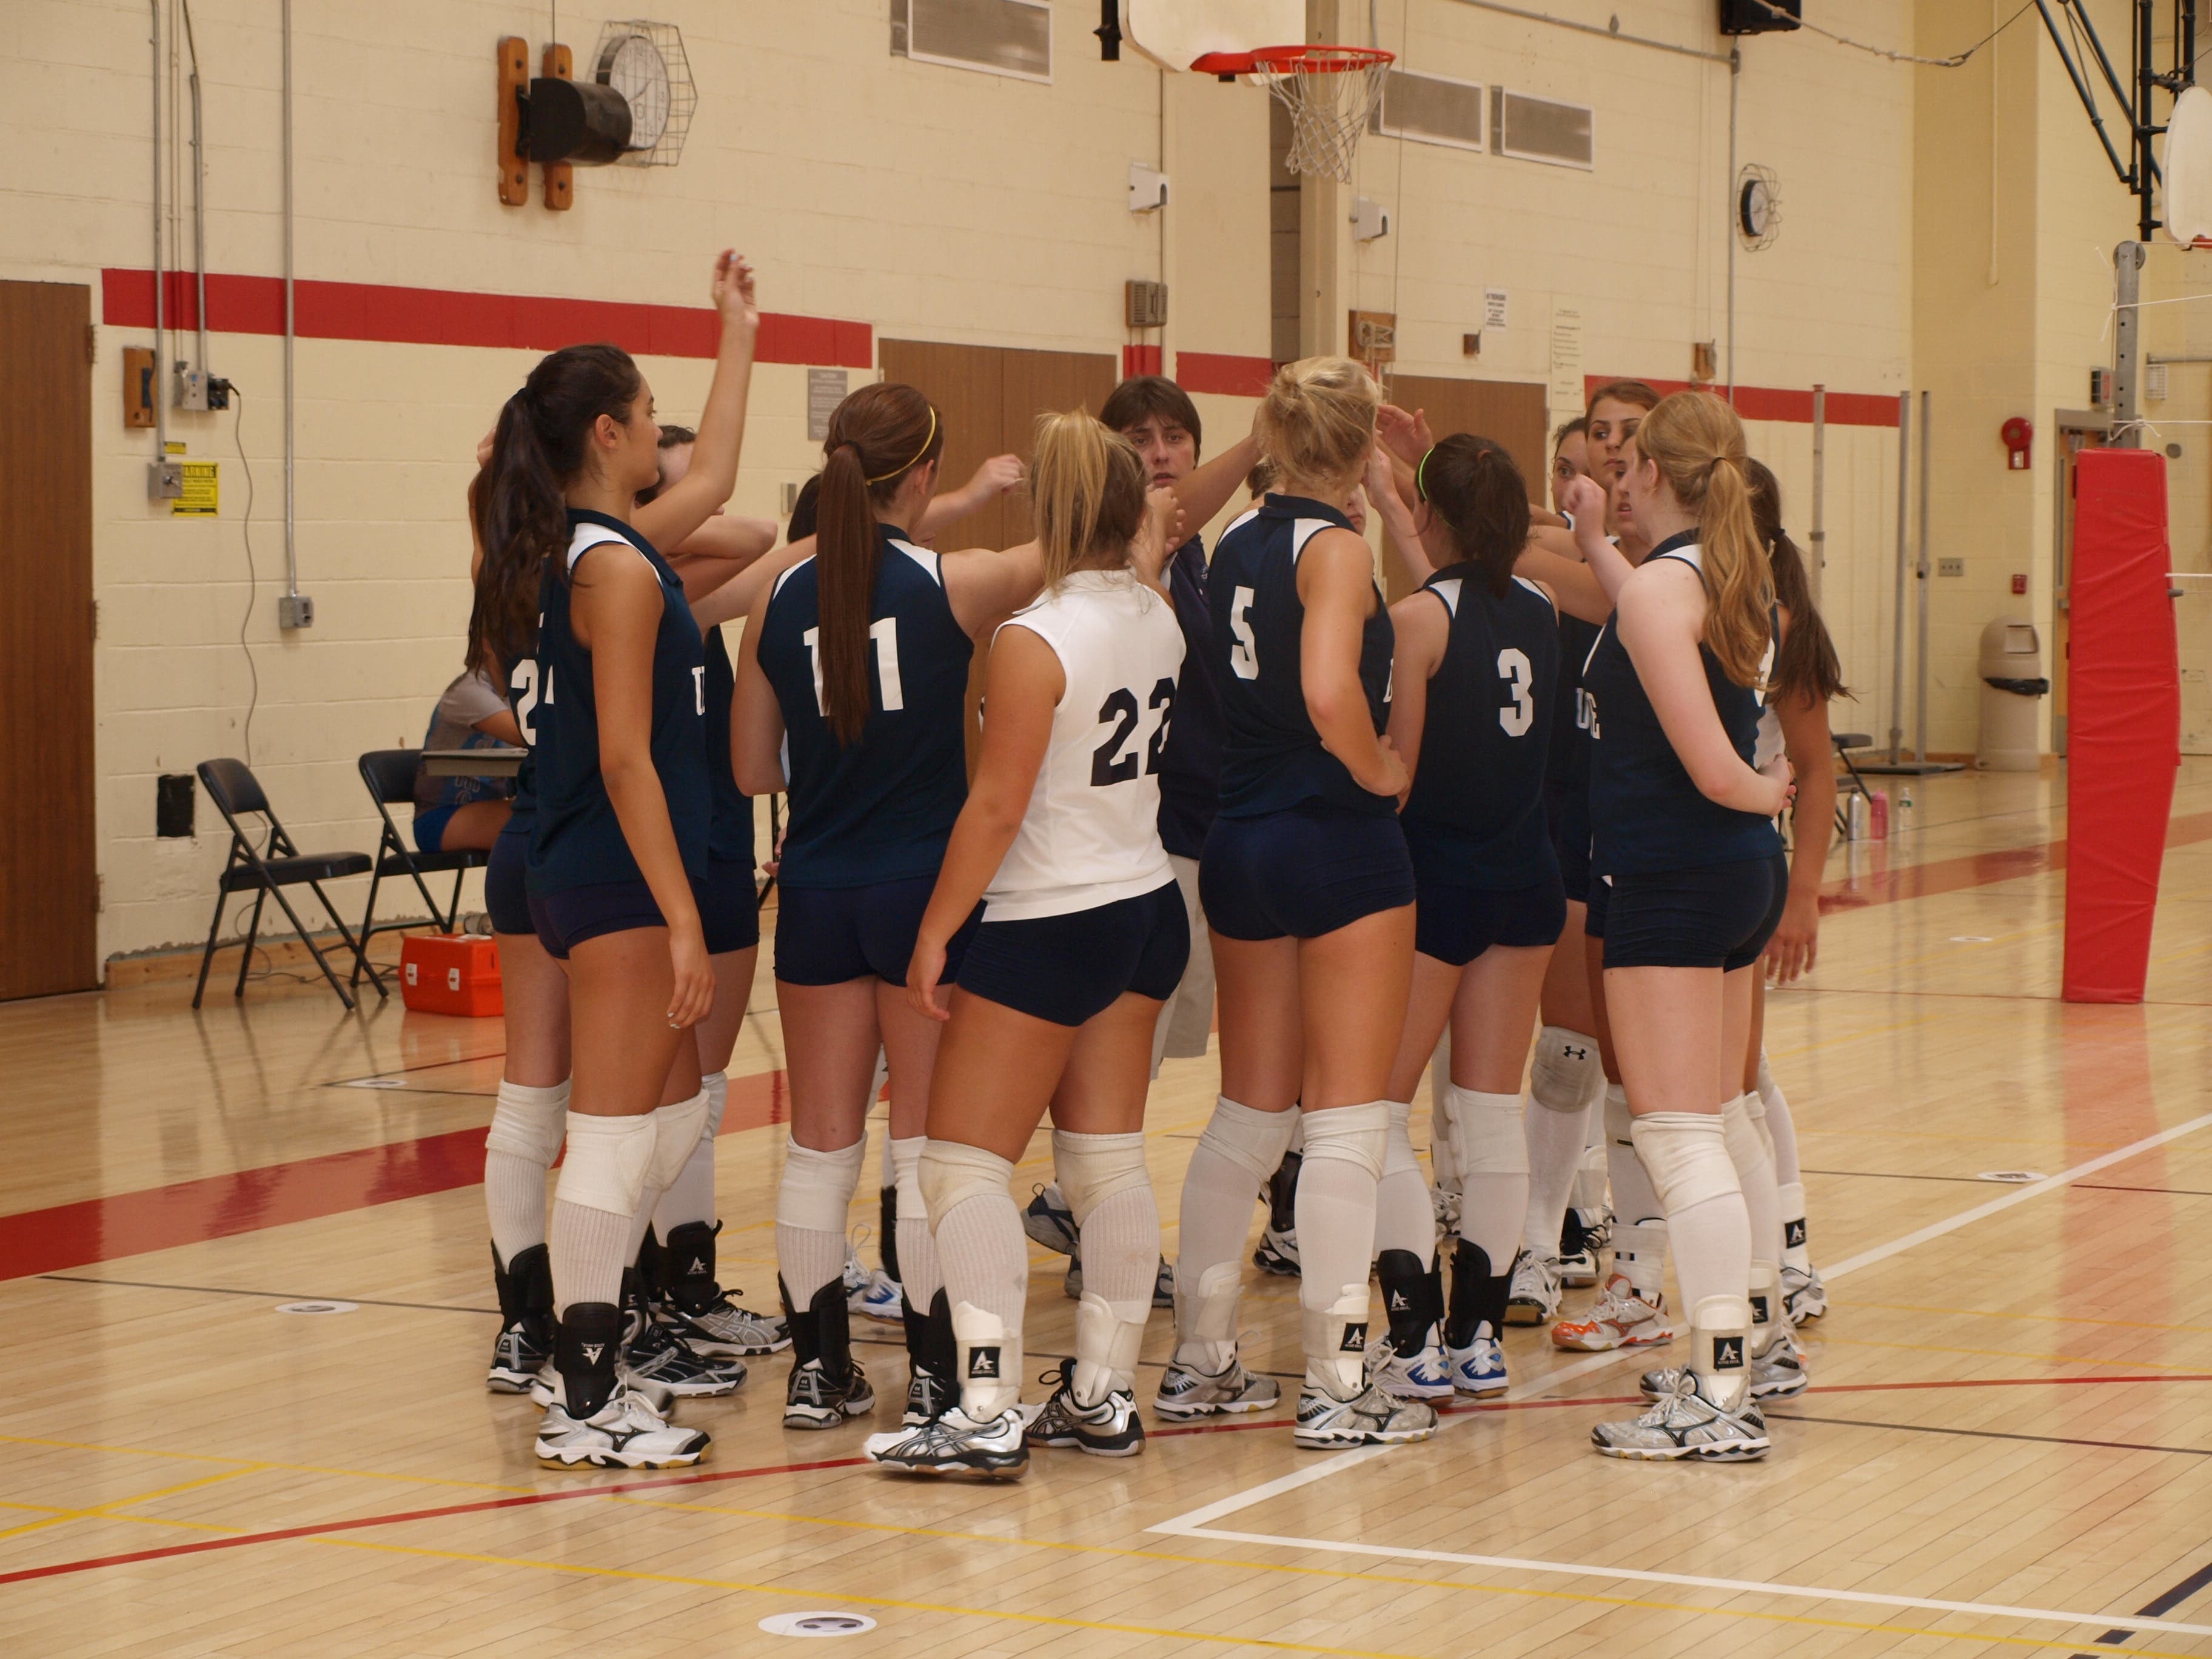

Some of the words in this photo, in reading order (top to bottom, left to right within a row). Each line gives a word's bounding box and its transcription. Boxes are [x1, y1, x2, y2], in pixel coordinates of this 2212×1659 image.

[184, 466, 214, 477] ARNING
[803, 617, 903, 717] 11
[1230, 585, 1259, 680] 5
[1090, 677, 1178, 786] 22
[1497, 648, 1533, 737] 3
